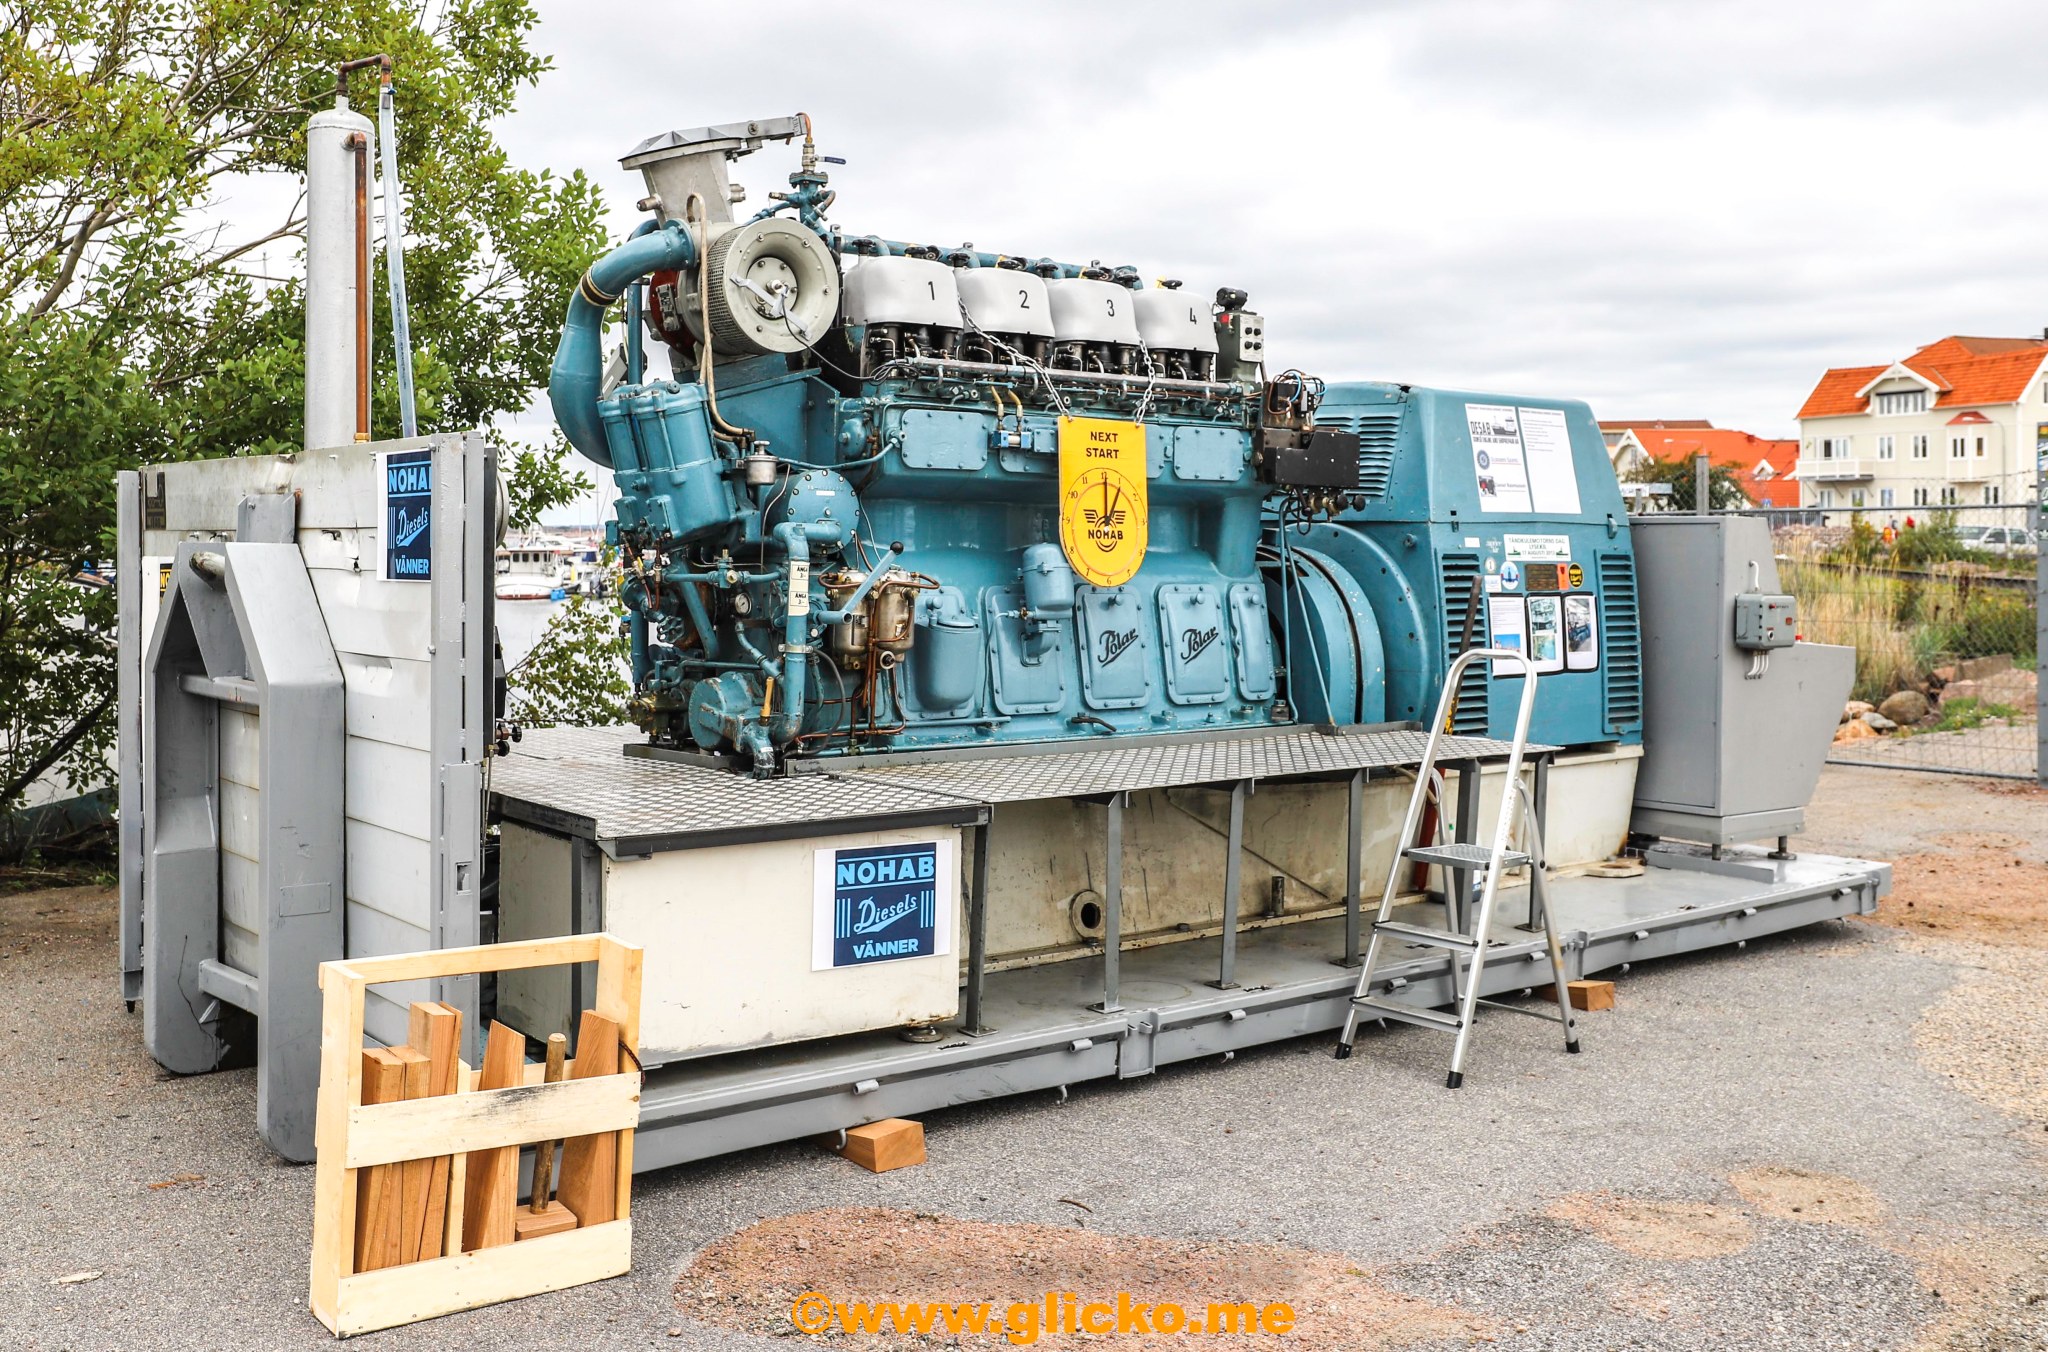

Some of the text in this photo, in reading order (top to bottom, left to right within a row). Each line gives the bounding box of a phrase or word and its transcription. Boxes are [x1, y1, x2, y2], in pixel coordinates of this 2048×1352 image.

[928, 281, 935, 300] 1
[1018, 290, 1030, 309] 2
[1107, 299, 1115, 317] 3
[1189, 307, 1197, 325] 4
[1090, 431, 1118, 443] NEXT
[1470, 421, 1491, 435] DESAB
[1086, 448, 1120, 459] START
[388, 466, 431, 492] NOHA
[1082, 472, 1088, 485] 11
[1070, 491, 1078, 499] 10
[396, 506, 428, 546] Diesels
[1088, 529, 1123, 540] NOHAB
[395, 555, 429, 574] VÄNNER
[1106, 577, 1112, 585] 6
[1098, 628, 1137, 664] Polar
[1181, 626, 1217, 662] Polar
[837, 856, 935, 886] NOHAB
[853, 894, 918, 933] Diesels
[853, 938, 919, 959] VÄNNER
